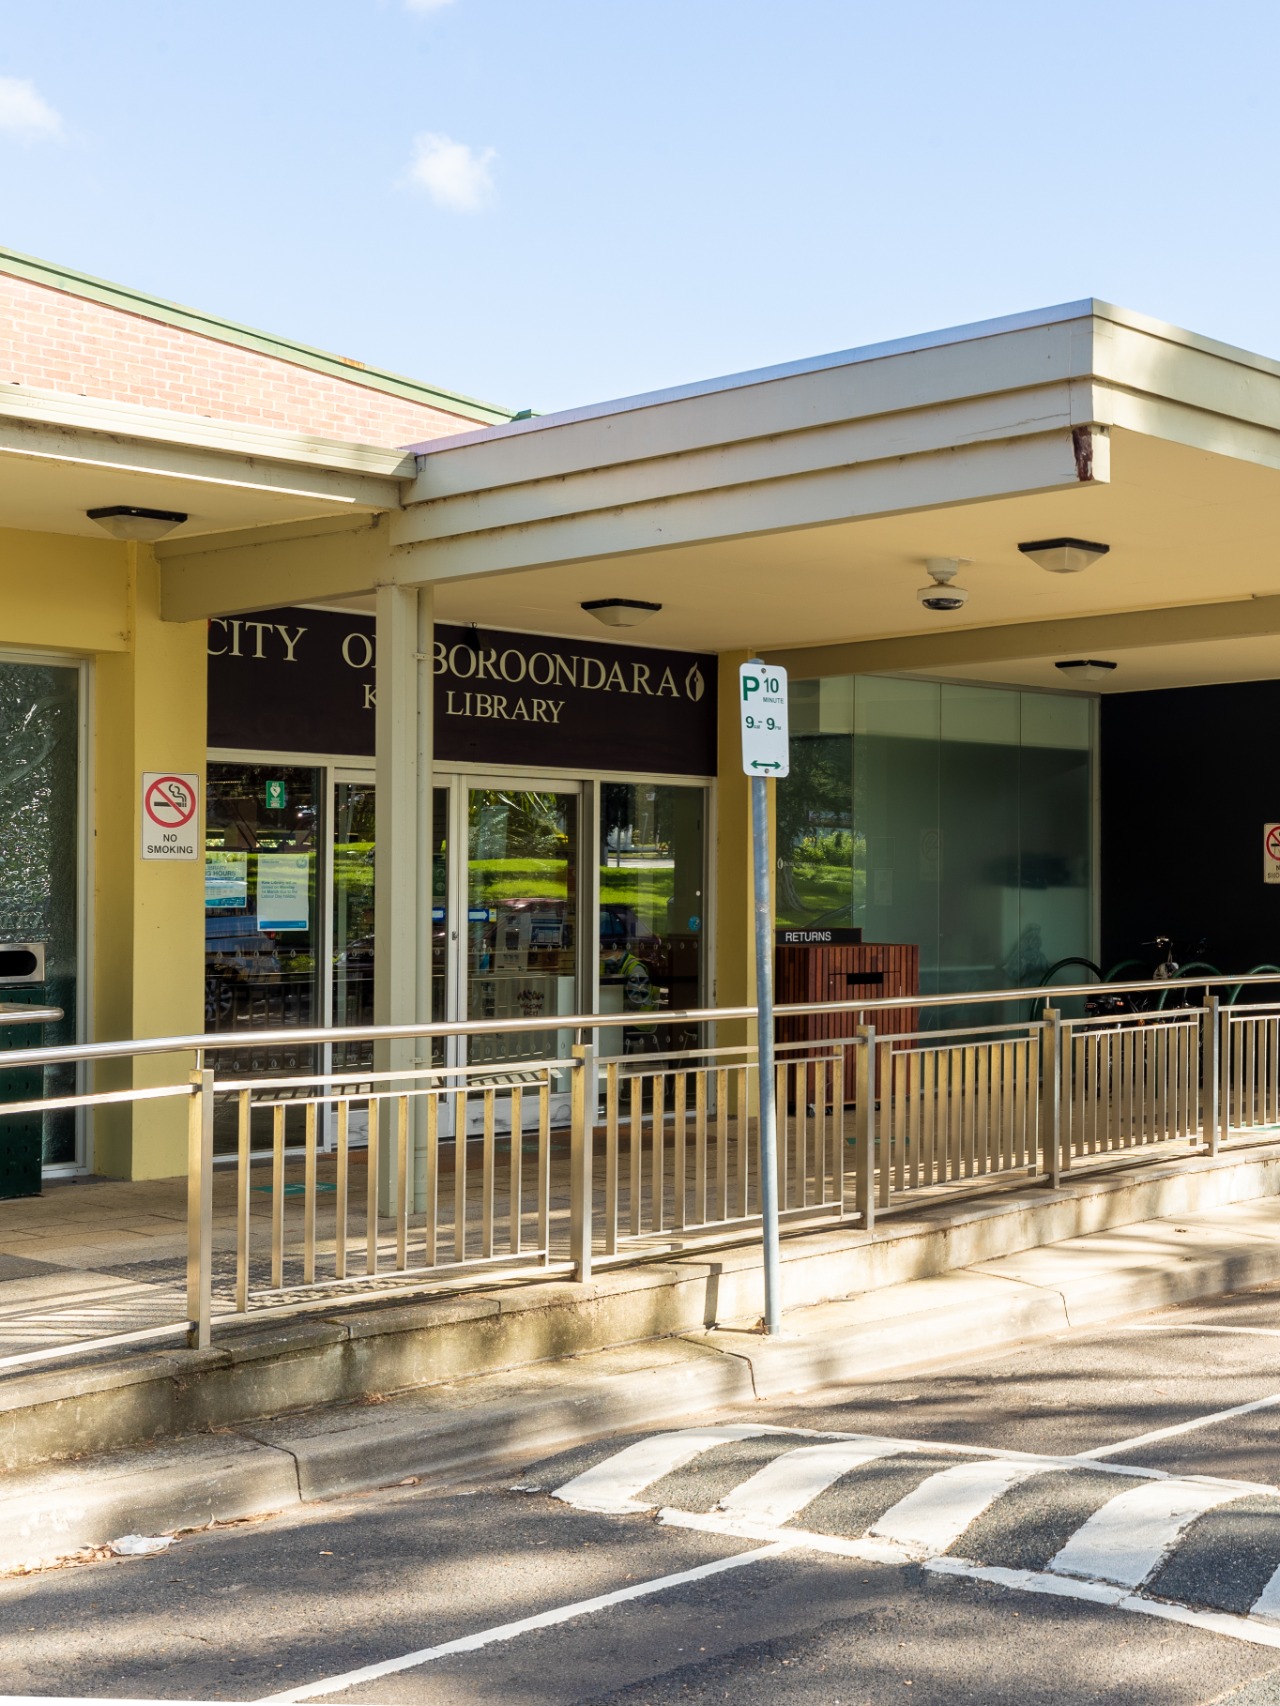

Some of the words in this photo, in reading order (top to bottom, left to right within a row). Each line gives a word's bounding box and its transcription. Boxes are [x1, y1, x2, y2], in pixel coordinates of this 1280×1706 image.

[207, 618, 308, 662] CITY
[341, 632, 376, 669] O
[433, 641, 681, 698] BOROONDARA
[742, 675, 760, 701] P
[763, 677, 780, 693] 10
[445, 690, 566, 724] LIBRARY
[162, 834, 178, 842] NO
[147, 845, 193, 854] SMOKING
[785, 931, 832, 942] RETURNS
